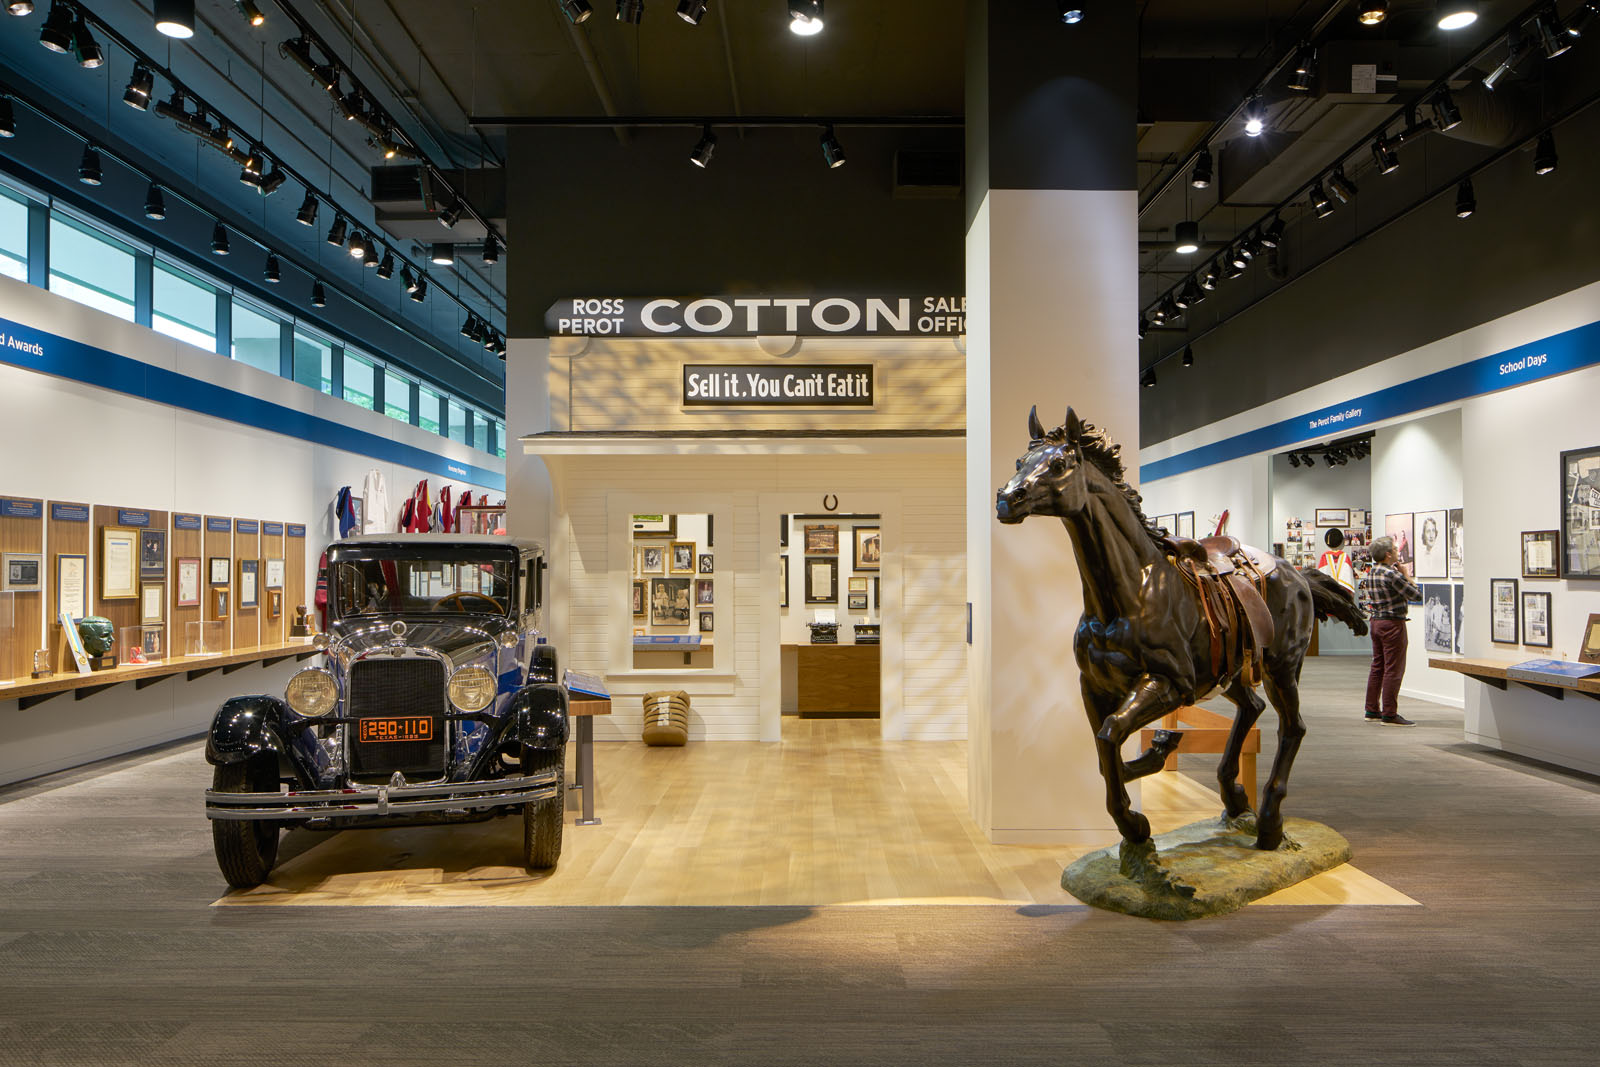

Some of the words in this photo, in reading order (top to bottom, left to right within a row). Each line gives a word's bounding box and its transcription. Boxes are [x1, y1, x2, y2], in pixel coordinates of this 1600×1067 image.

[573, 299, 624, 315] ROSS
[641, 298, 910, 333] COTTON
[559, 318, 624, 334] PEROT
[917, 316, 966, 333] OFFI
[7, 336, 44, 356] Awards
[1499, 358, 1526, 375] School
[1527, 353, 1547, 367] Days
[688, 373, 720, 397] Sell
[746, 373, 780, 397] You
[783, 373, 825, 397] Can't
[1309, 420, 1318, 429] The
[1317, 417, 1330, 427] Perot
[1329, 412, 1345, 423] Family
[1345, 408, 1363, 419] Gallery
